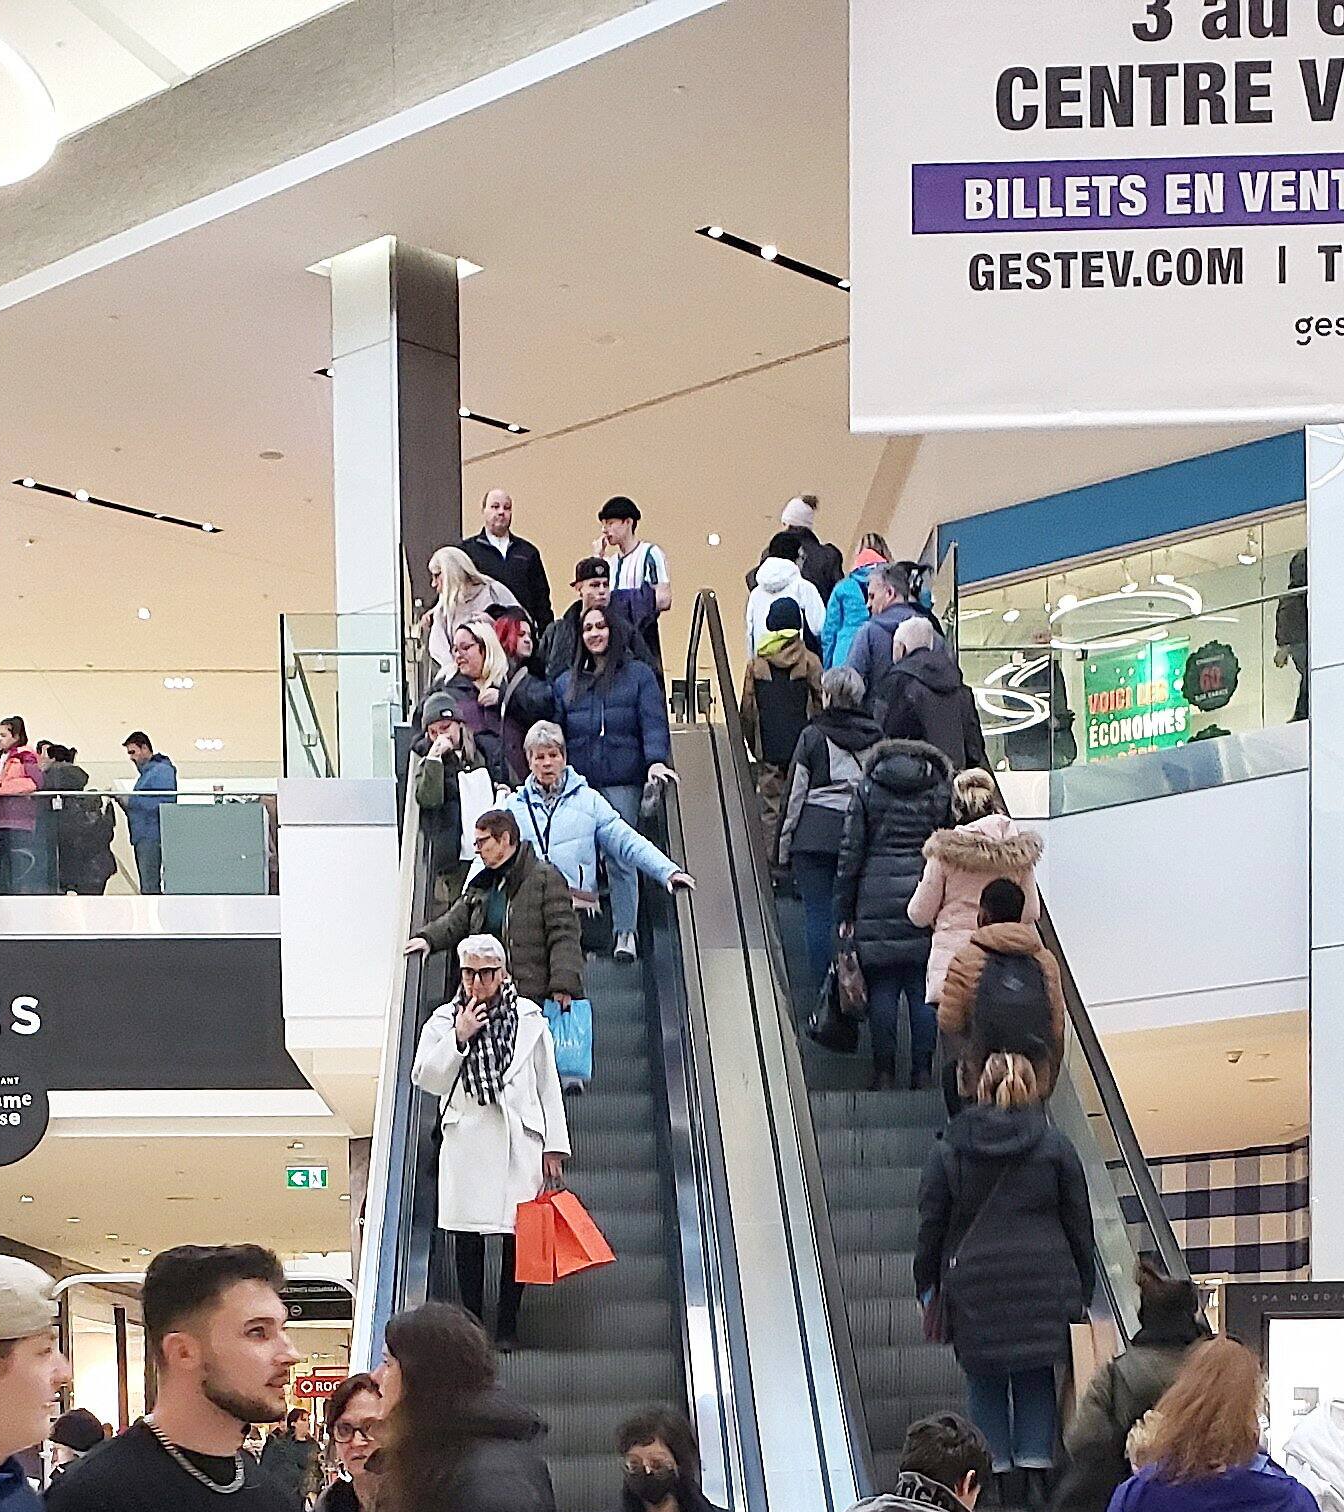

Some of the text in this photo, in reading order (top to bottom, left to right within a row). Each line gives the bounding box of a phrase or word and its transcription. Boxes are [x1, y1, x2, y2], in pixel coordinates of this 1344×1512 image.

[1131, 0, 1174, 41] 3
[1201, 0, 1289, 40] au
[995, 60, 1274, 131] CENTRE
[963, 173, 1148, 220] BILLETS
[1164, 172, 1225, 216] EN
[968, 246, 1244, 291] GESTEV.COM
[1088, 686, 1134, 715] VOICI
[1088, 706, 1188, 748] ÉCONOMIES
